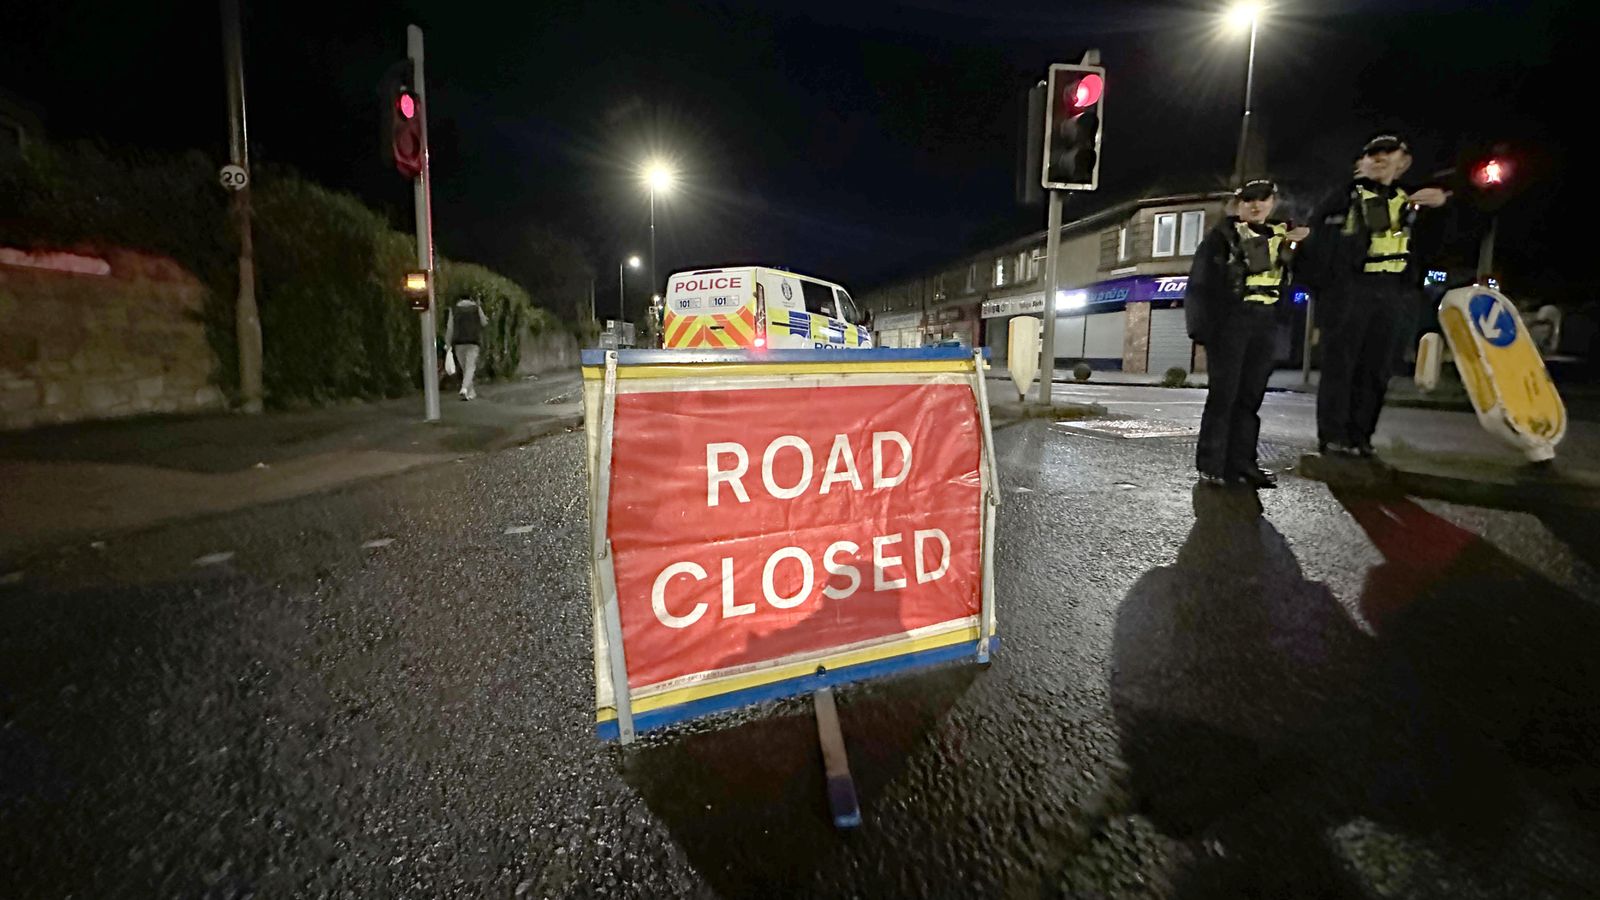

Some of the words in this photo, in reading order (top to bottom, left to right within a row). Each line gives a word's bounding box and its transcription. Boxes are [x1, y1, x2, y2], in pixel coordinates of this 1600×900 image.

[222, 171, 246, 188] 20
[675, 277, 742, 293] POLICE
[679, 299, 690, 308] 101
[714, 297, 727, 306] 101
[706, 430, 913, 507] ROAD
[650, 528, 952, 629] CLOSED
